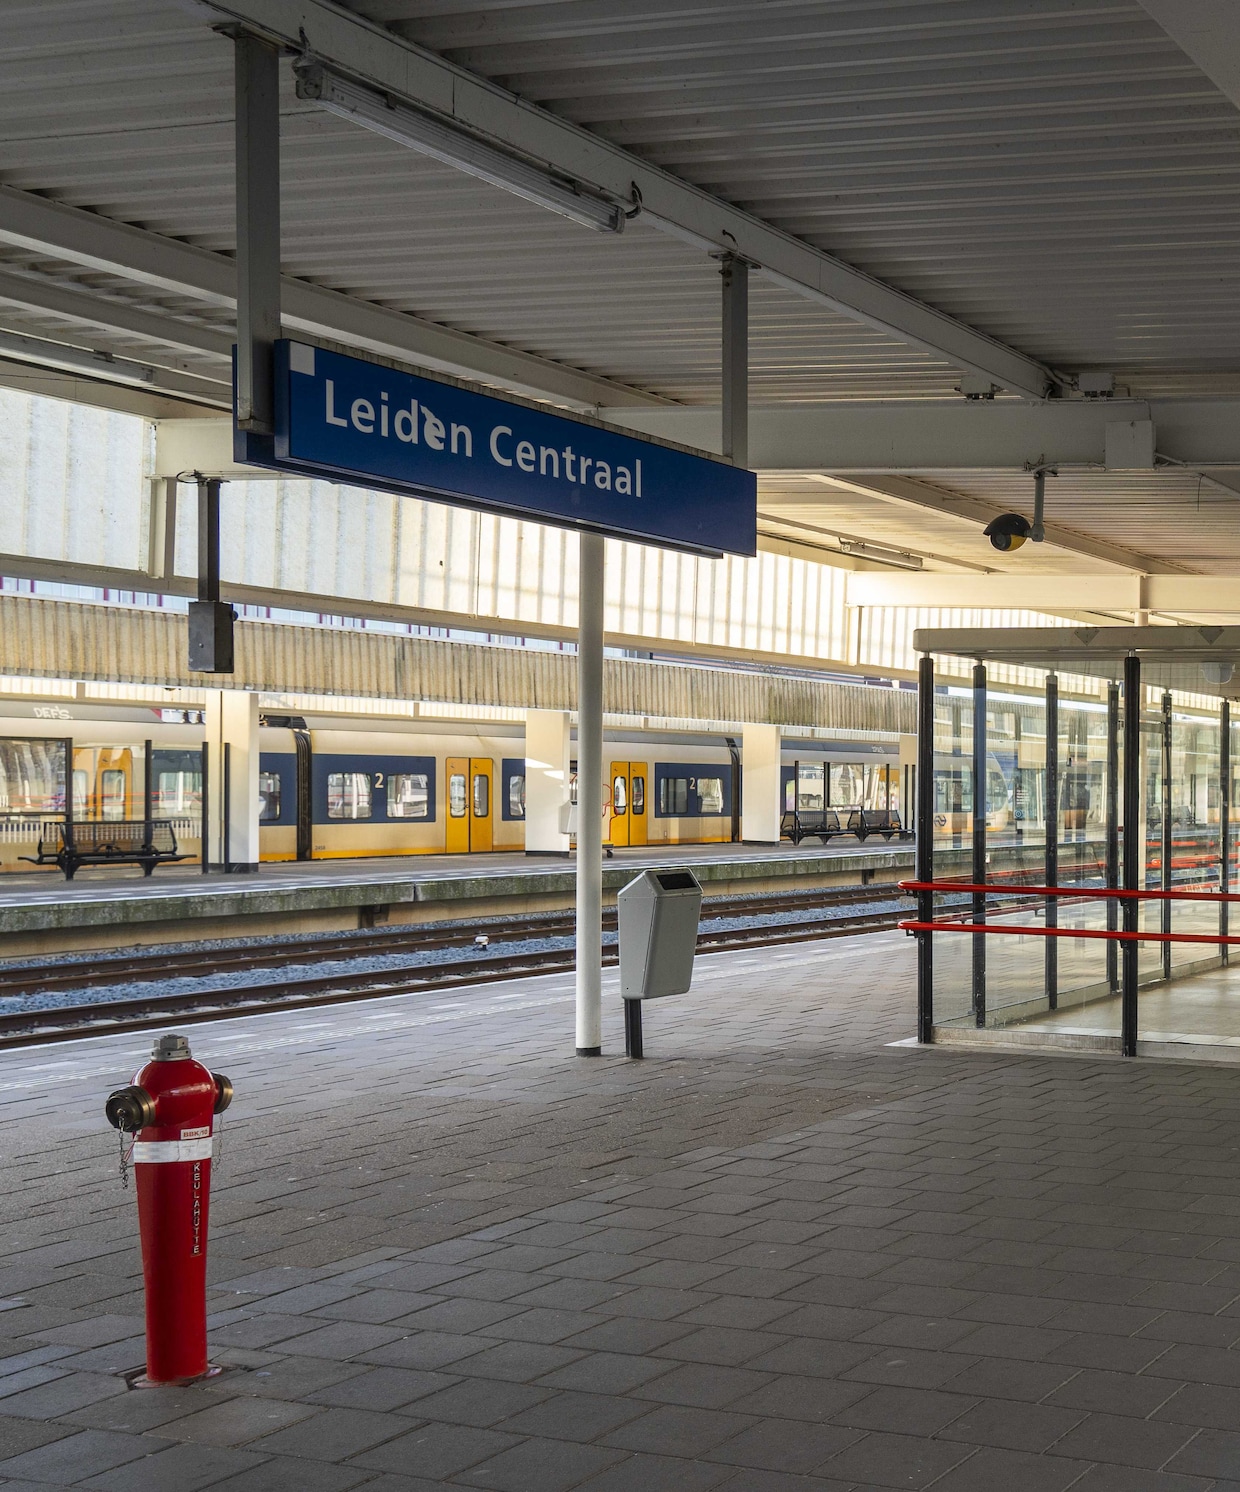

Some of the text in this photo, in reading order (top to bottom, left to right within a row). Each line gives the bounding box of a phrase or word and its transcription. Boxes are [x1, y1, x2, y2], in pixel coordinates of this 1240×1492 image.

[325, 378, 642, 498] Leiden Centraal
[374, 772, 384, 789] 2
[689, 777, 696, 790] 2
